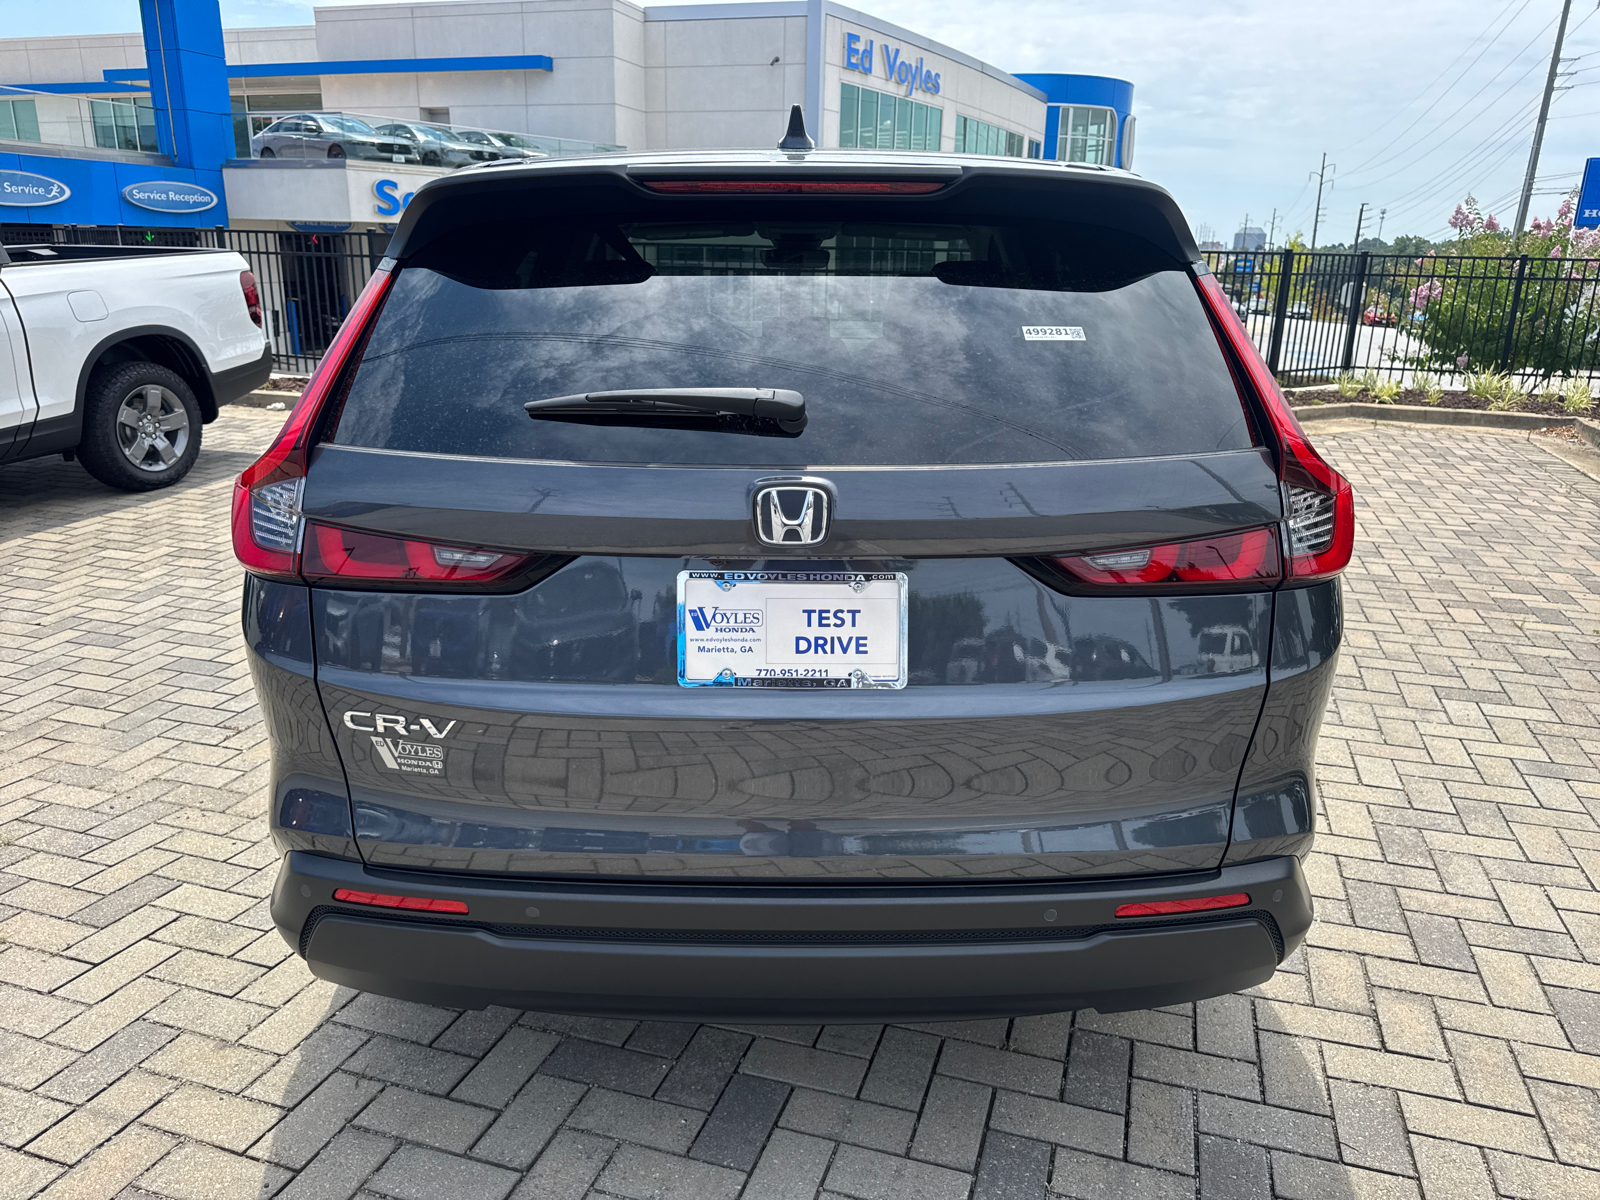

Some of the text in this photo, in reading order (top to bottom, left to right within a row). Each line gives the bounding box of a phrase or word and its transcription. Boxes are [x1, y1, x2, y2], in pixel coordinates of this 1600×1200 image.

[845, 31, 941, 97] Ed Voyles
[3, 181, 46, 195] Service
[132, 189, 211, 204] Service Reception
[1025, 327, 1070, 336] 499281
[802, 609, 862, 628] TEST
[697, 645, 754, 654] Marietta, GA
[794, 636, 869, 655] DRIVE
[755, 668, 829, 677] 770-951-2211
[823, 679, 849, 688] GA
[343, 710, 457, 739] CR-V
[384, 737, 442, 758] VOYLES
[397, 758, 432, 767] HONDA
[401, 765, 429, 775] Marietta,
